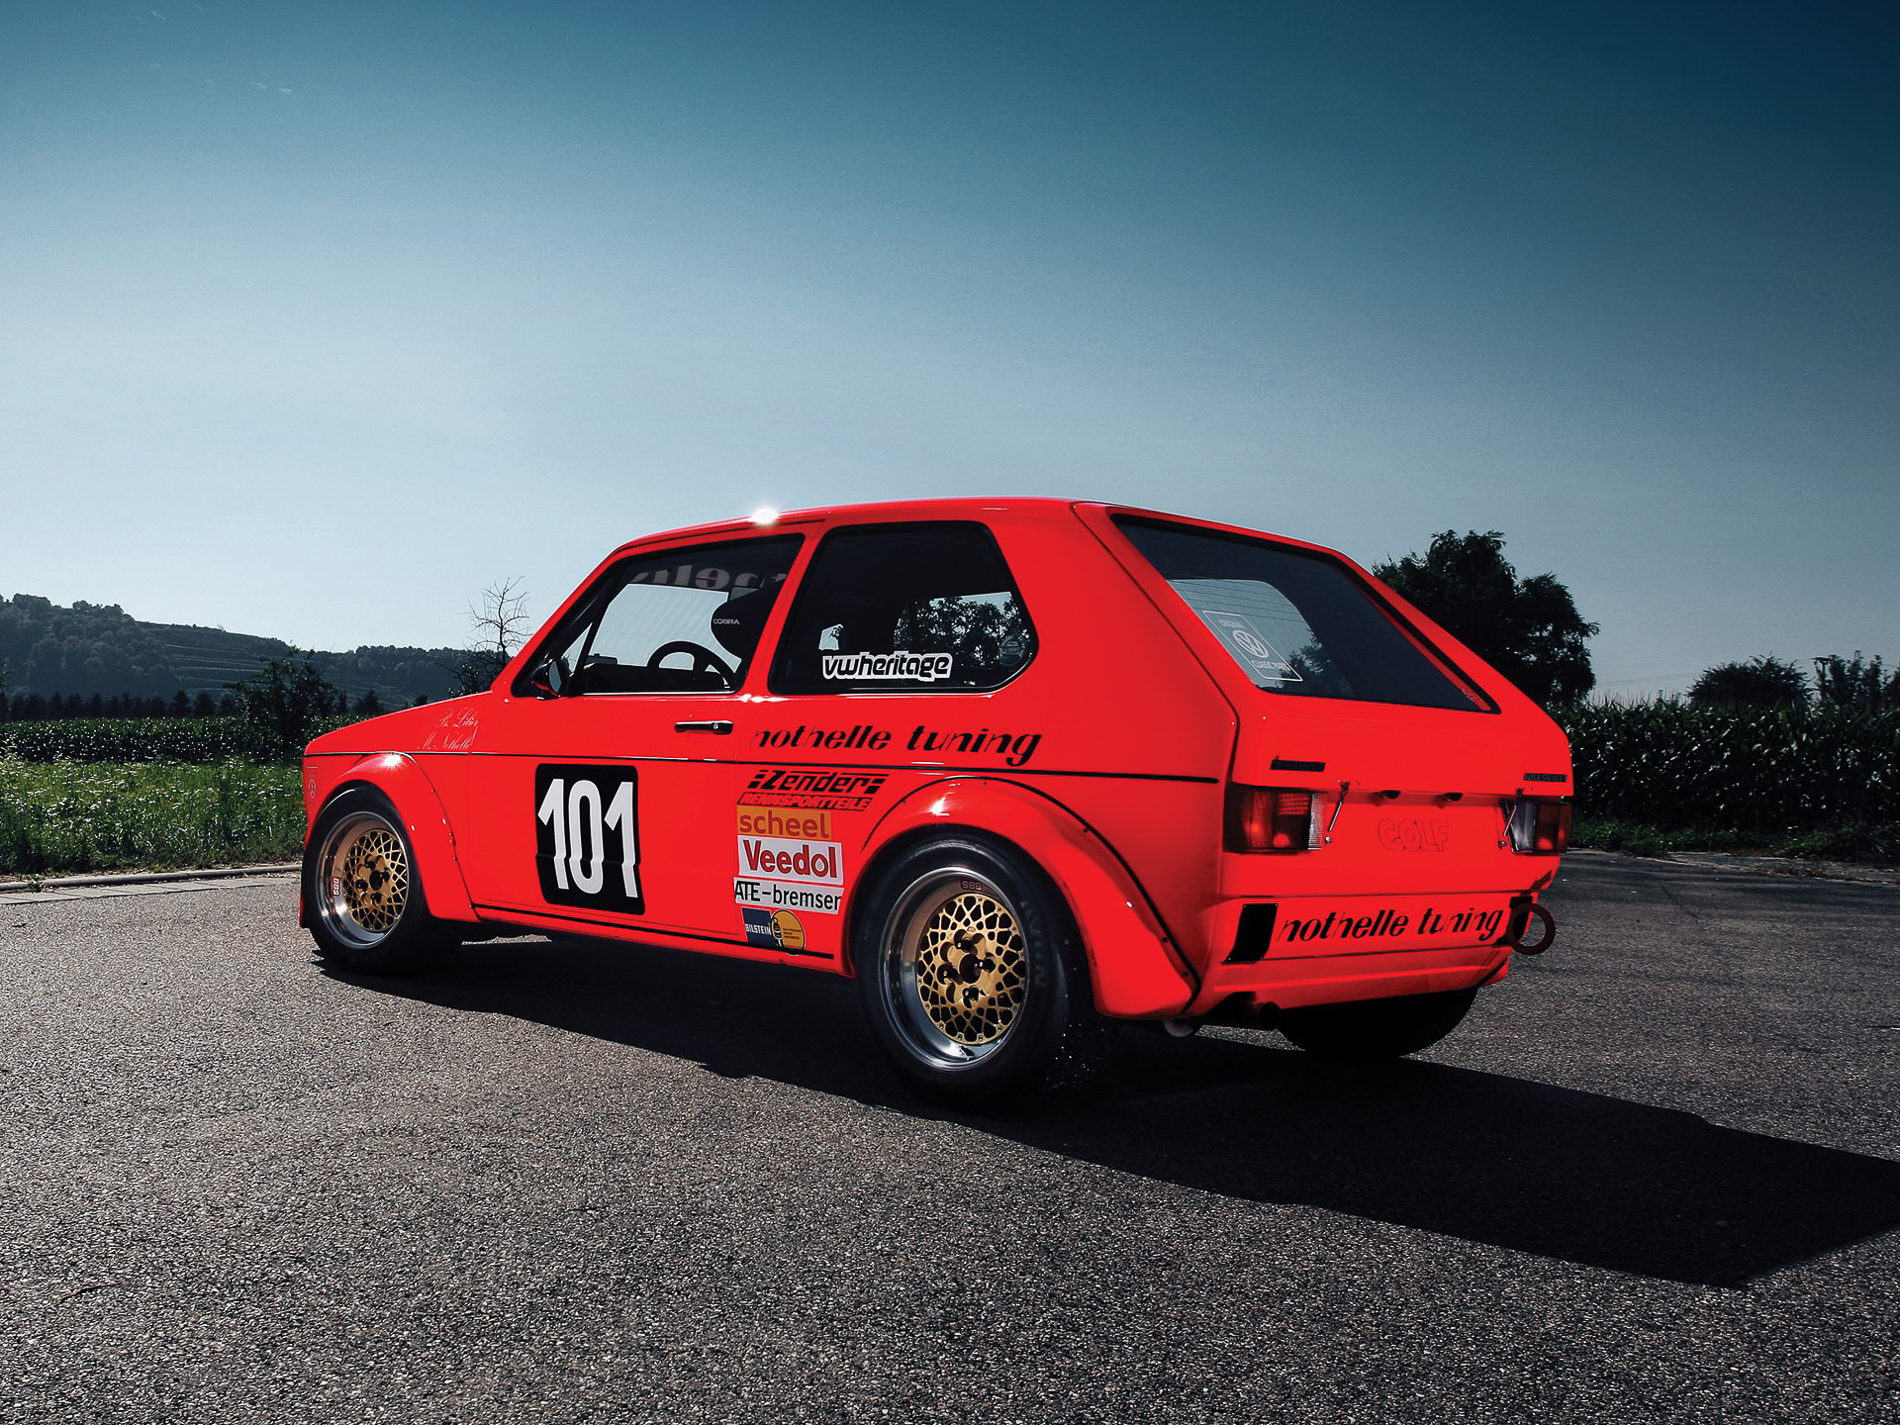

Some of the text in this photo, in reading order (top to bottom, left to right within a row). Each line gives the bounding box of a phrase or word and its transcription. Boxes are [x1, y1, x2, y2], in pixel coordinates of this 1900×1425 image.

[713, 617, 740, 625] COBRA
[822, 651, 952, 682] vwheritage
[750, 725, 1043, 767] nothelle tuning
[759, 769, 872, 794] Zender
[537, 778, 639, 899] 101
[739, 810, 830, 839] scheel
[743, 839, 838, 878] Veedol
[745, 923, 772, 936] BILSTEIN
[1277, 907, 1504, 942] nothelle tuning
